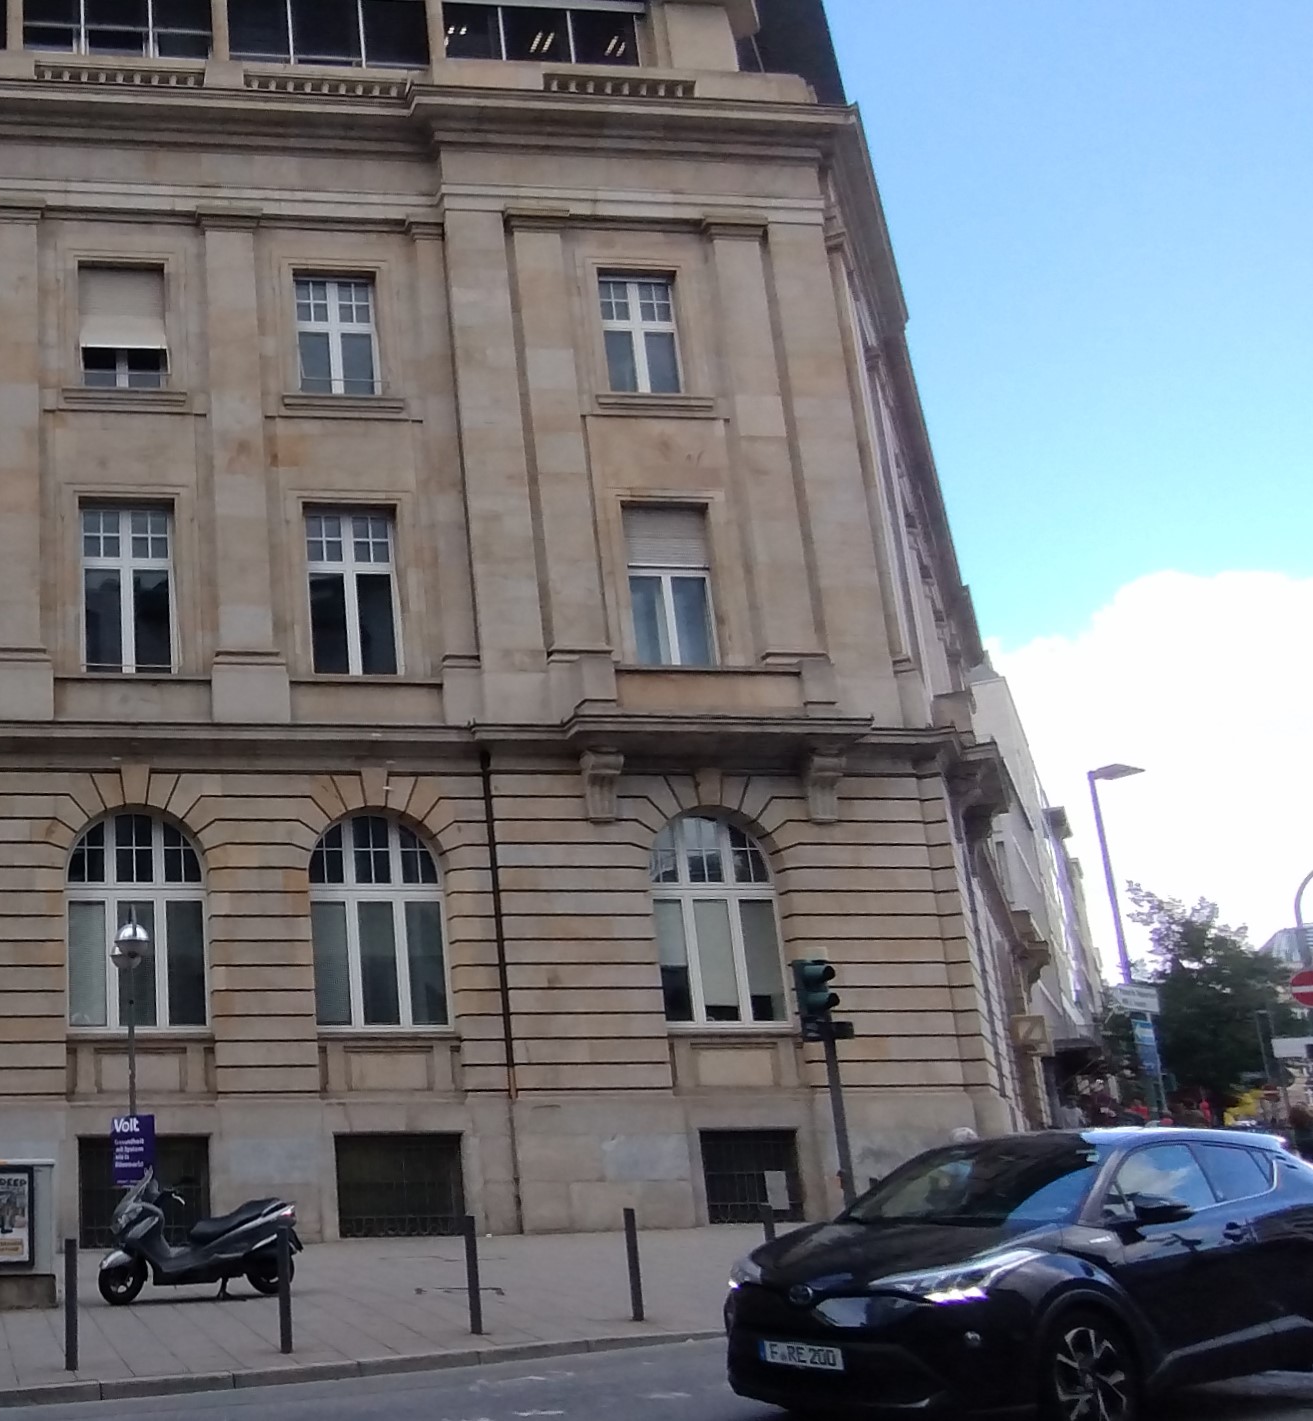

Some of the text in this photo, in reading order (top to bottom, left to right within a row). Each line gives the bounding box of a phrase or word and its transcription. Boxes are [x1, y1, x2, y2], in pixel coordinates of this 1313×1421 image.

[113, 1117, 140, 1133] Volt
[769, 1343, 837, 1367] F RE 200
